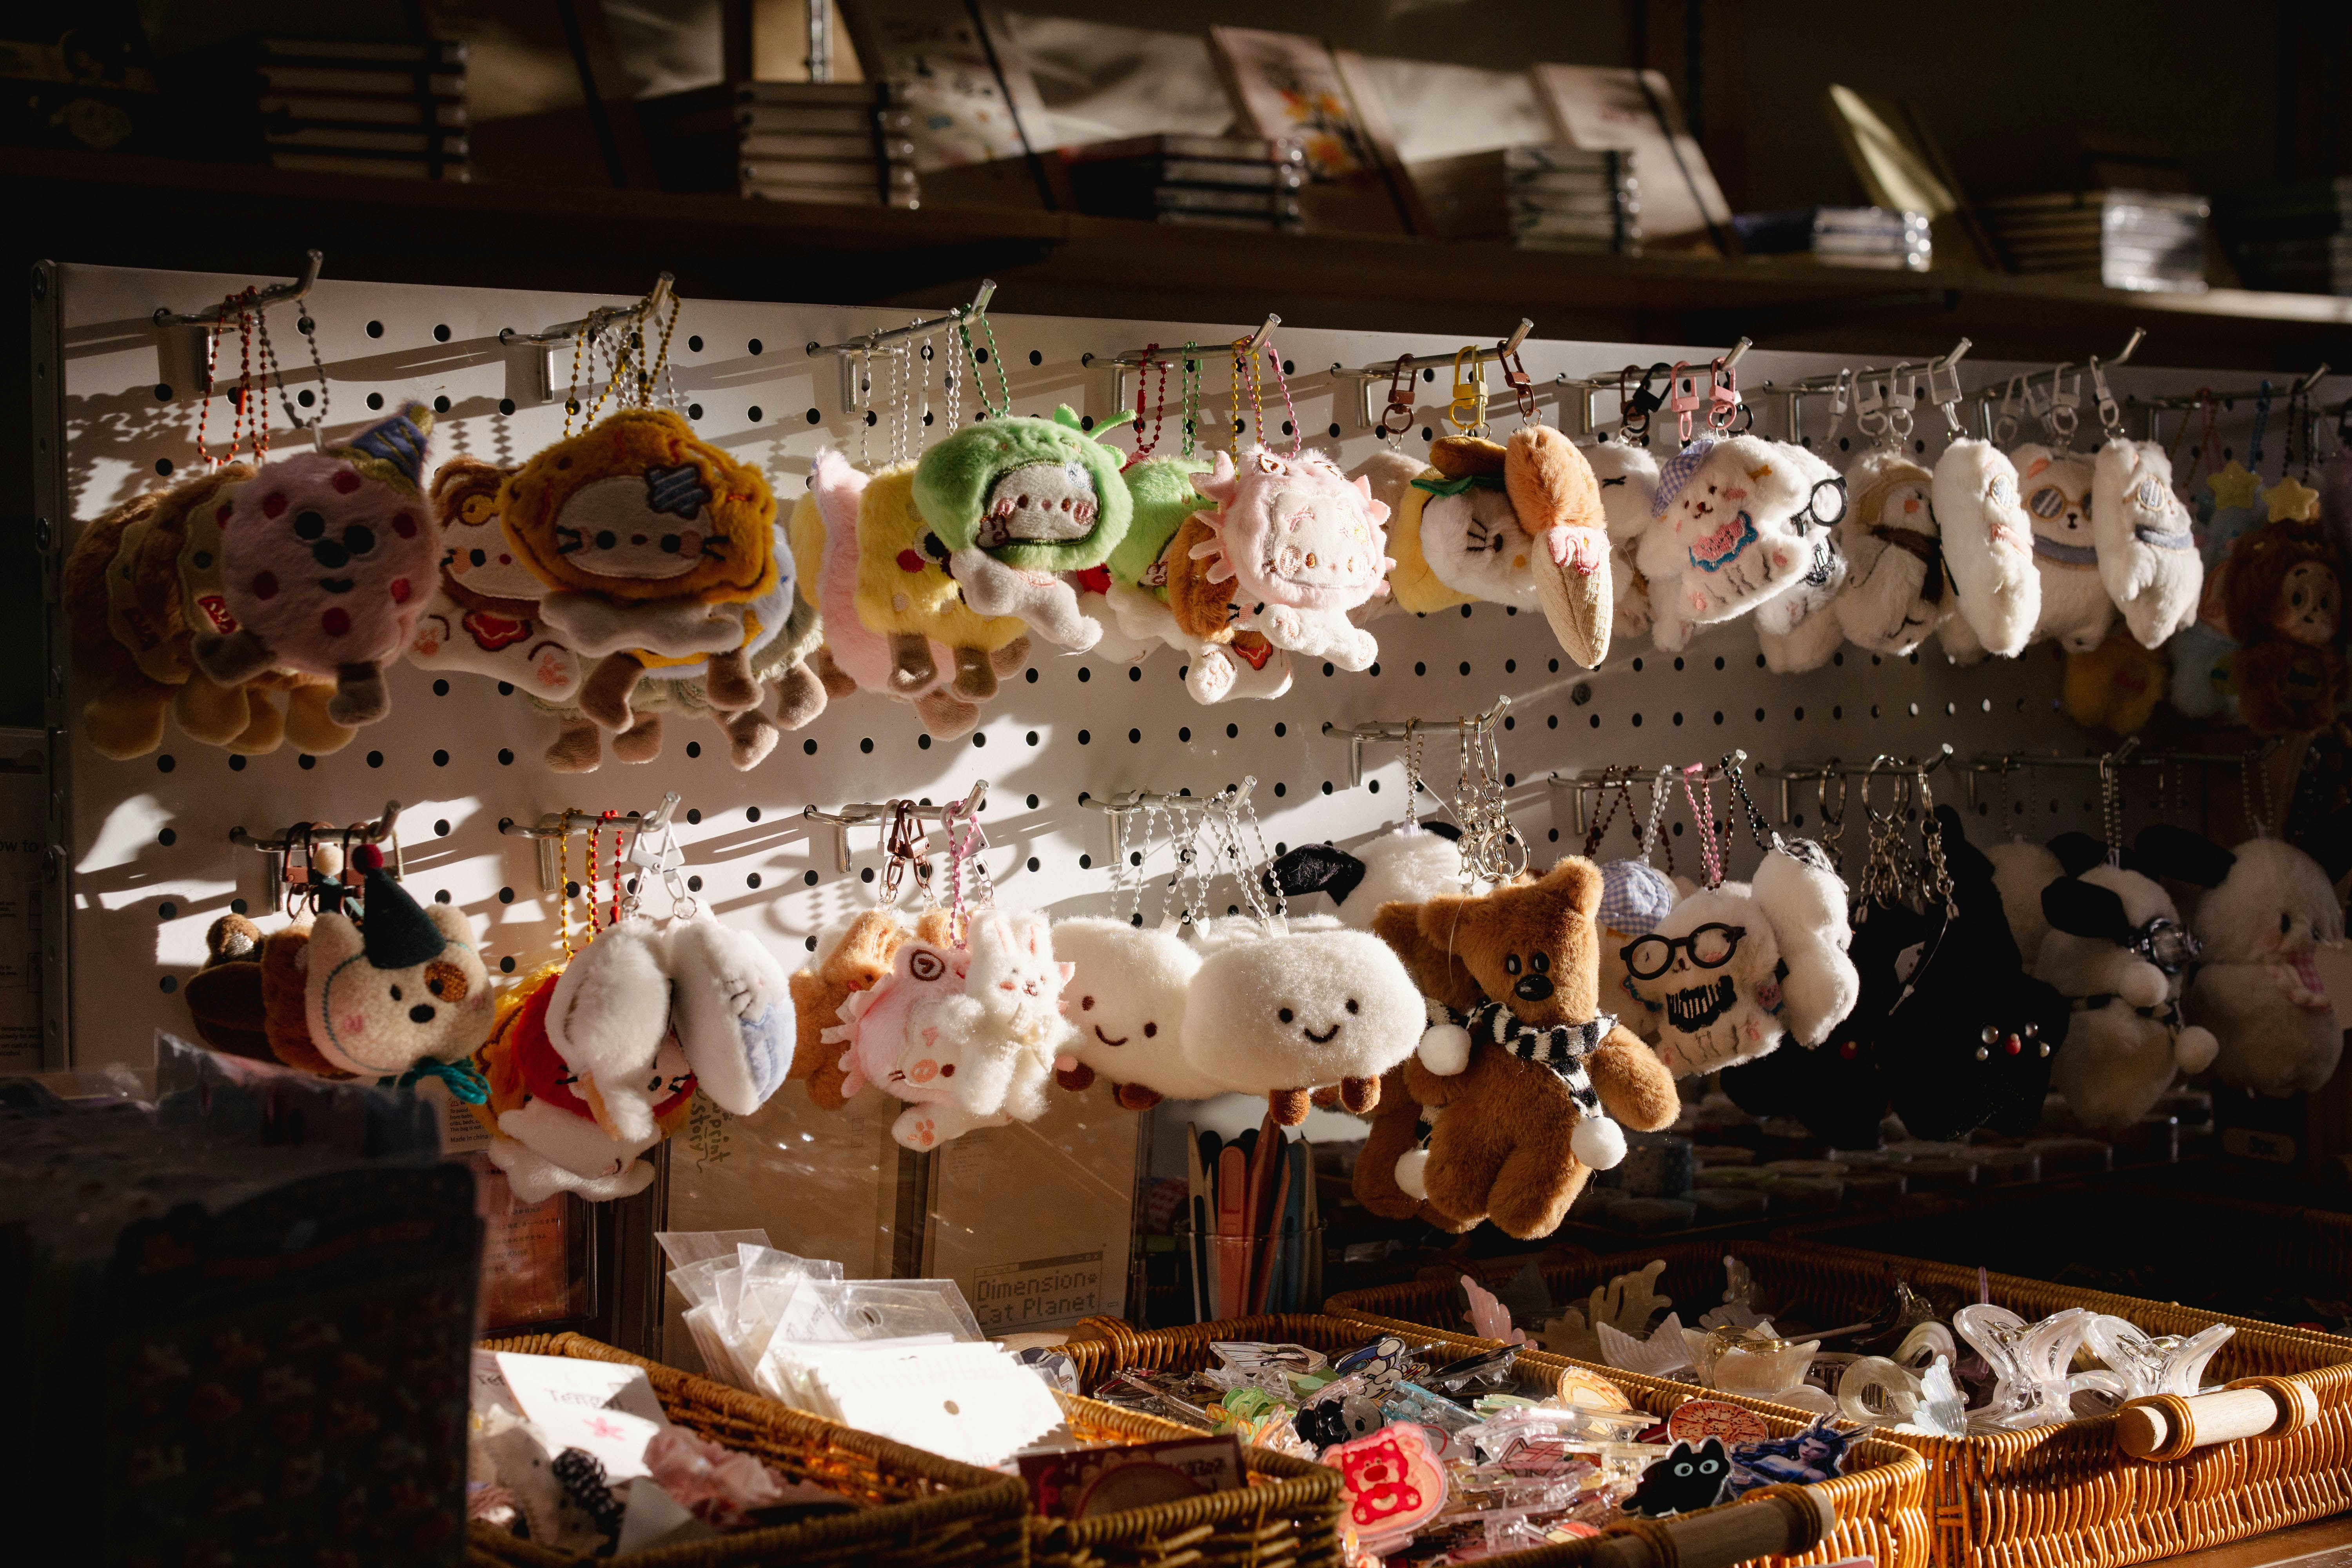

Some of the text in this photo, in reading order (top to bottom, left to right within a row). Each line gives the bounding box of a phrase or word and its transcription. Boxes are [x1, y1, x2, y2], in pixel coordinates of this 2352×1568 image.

[22, 839, 39, 853] to
[976, 1270, 1087, 1302] Dimension
[976, 1292, 1096, 1325] Cat Planet
